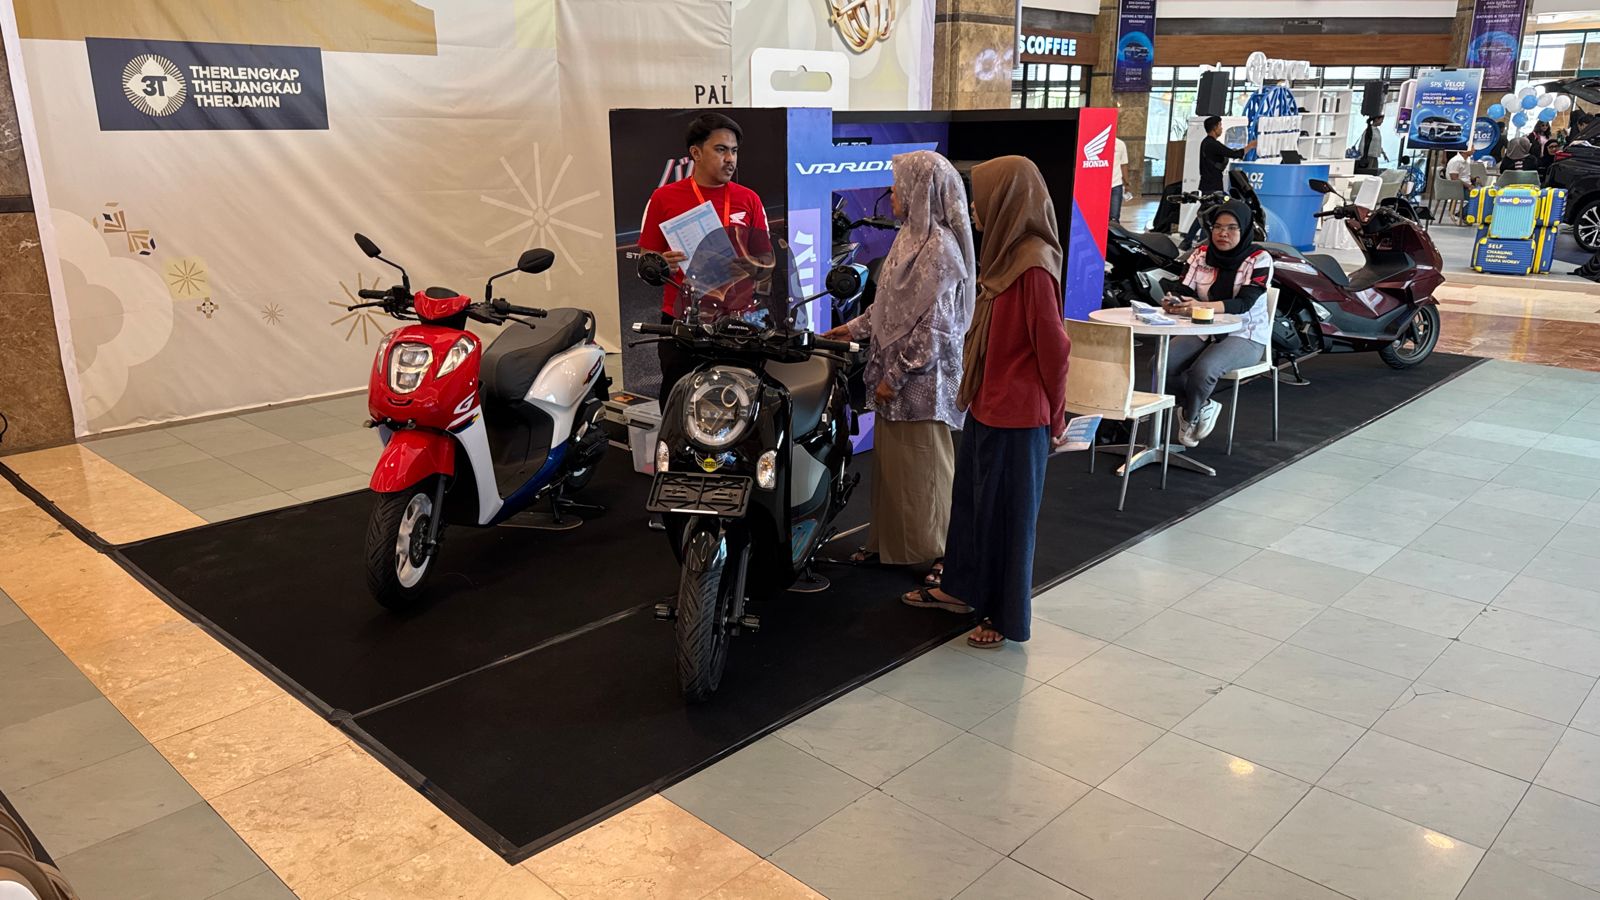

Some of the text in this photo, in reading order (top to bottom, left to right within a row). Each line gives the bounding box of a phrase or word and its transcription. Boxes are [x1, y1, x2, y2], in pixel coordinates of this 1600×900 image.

[1026, 35, 1076, 56] COFFEE
[189, 65, 300, 81] THERLENGKAP
[140, 75, 167, 97] 3T
[191, 79, 302, 95] THERJANGKAU
[694, 84, 732, 104] PAL
[193, 94, 280, 108] THERJAMIN
[1082, 160, 1110, 168] HONDA
